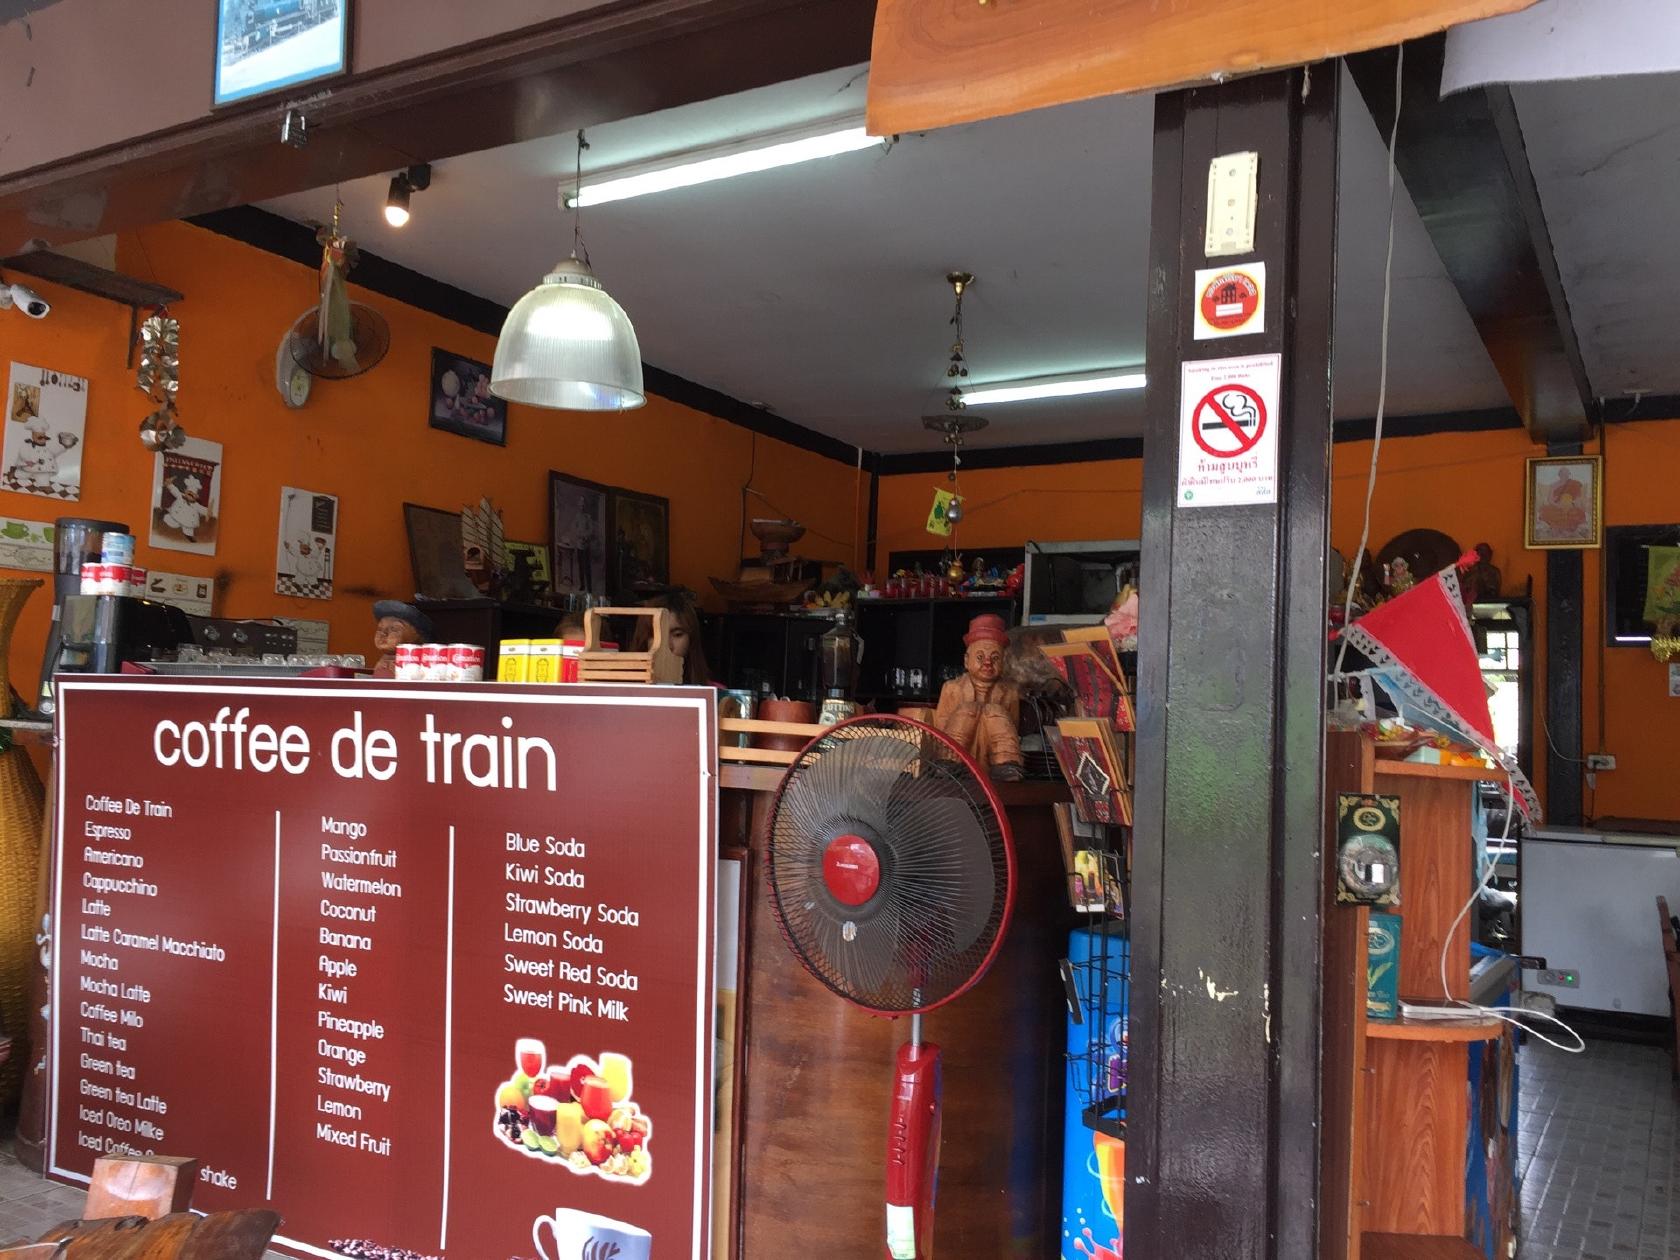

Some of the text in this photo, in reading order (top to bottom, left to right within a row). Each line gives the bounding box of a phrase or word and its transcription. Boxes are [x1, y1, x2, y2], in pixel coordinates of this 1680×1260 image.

[155, 707, 558, 791] coffee de train
[86, 795, 173, 818] Coffee De Train
[85, 821, 132, 841] Espresso
[322, 815, 369, 839] Mango
[84, 847, 144, 869] Americano
[322, 844, 398, 868] Passionfruit
[506, 833, 586, 858] Blue Soda
[321, 872, 402, 898] Watermelon
[506, 863, 585, 888] Kiwi Soda
[82, 898, 112, 917] Latte
[320, 900, 377, 922] Coconut
[506, 893, 640, 927] Strawberry Soda
[82, 924, 226, 962] Latte Caramel Macchiato
[320, 927, 372, 950] Banana
[505, 922, 604, 954] Lemon Soda
[81, 949, 119, 970] Mocha
[319, 955, 358, 978] Apple
[505, 954, 639, 991] Sweet Red Soda
[81, 976, 152, 1003] Mocha Latte
[319, 983, 348, 1004] Kiwi
[81, 1002, 144, 1028] Coffee Milo
[504, 984, 630, 1022] Sweet Pink Milk
[318, 1011, 385, 1040] Pineapple
[80, 1027, 128, 1051] Thai tea
[318, 1039, 367, 1066] Orange
[81, 1053, 136, 1080] Green tea
[80, 1079, 168, 1115] Green tea Latte
[318, 1067, 392, 1102] Strawberry
[317, 1095, 362, 1120] Lemon
[80, 1105, 165, 1141] Iced Oreo Milke
[78, 1131, 103, 1152] Iced
[317, 1123, 392, 1157] Mixed Fruit
[200, 1165, 238, 1190] shake
